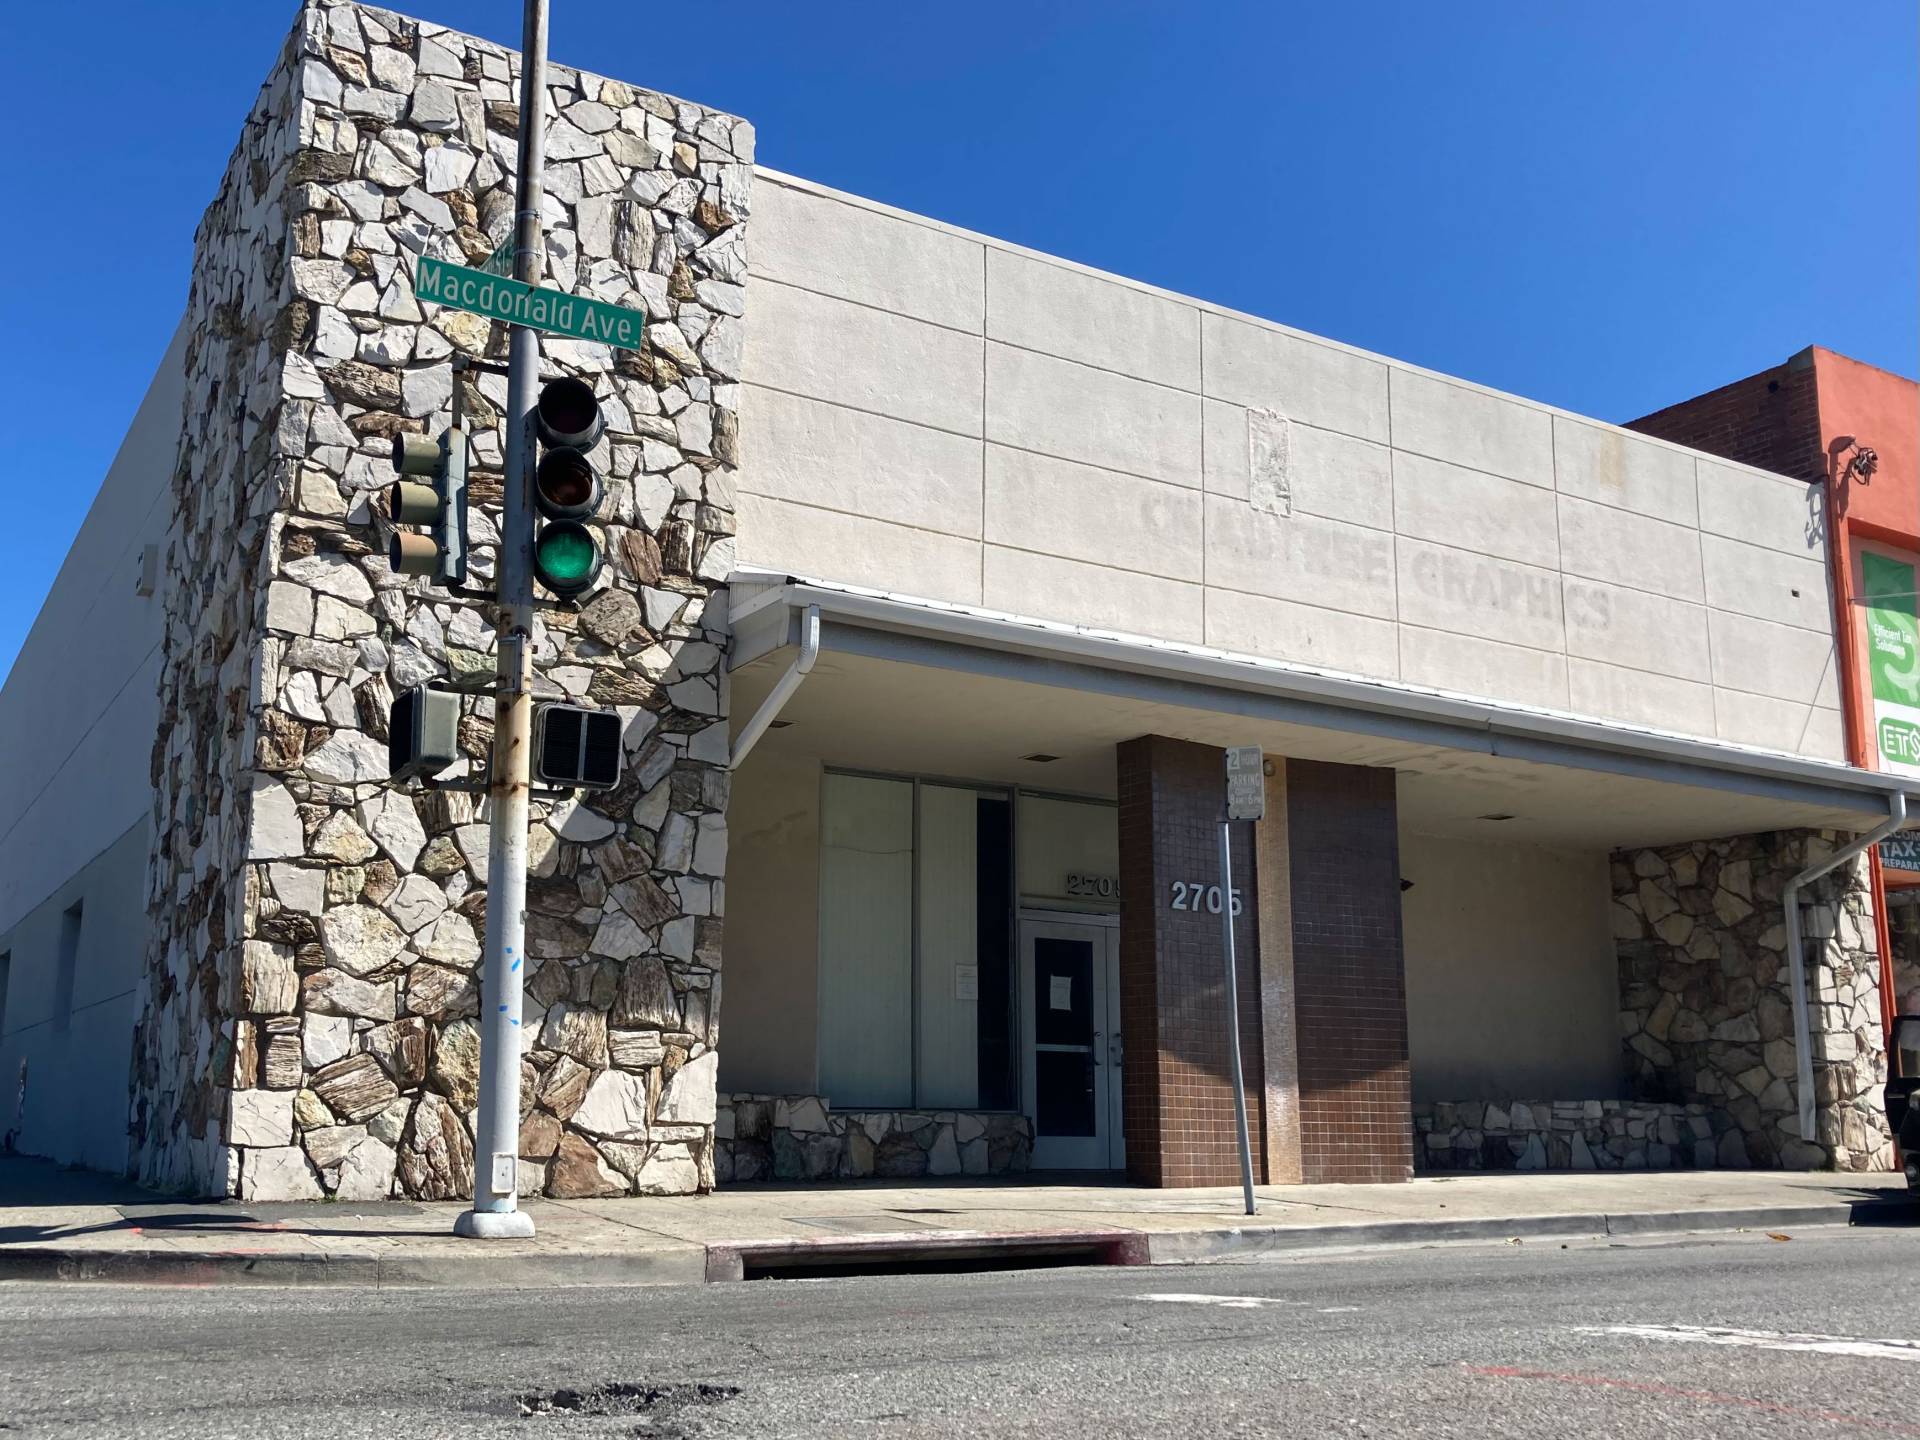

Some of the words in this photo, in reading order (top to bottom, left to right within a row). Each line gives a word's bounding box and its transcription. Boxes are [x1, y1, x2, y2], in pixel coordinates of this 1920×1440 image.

[419, 262, 574, 329] Macdonald
[1231, 752, 1238, 768] 2
[1230, 773, 1261, 787] PARKING
[1067, 872, 1119, 898] 270
[1171, 881, 1242, 916] 2705
